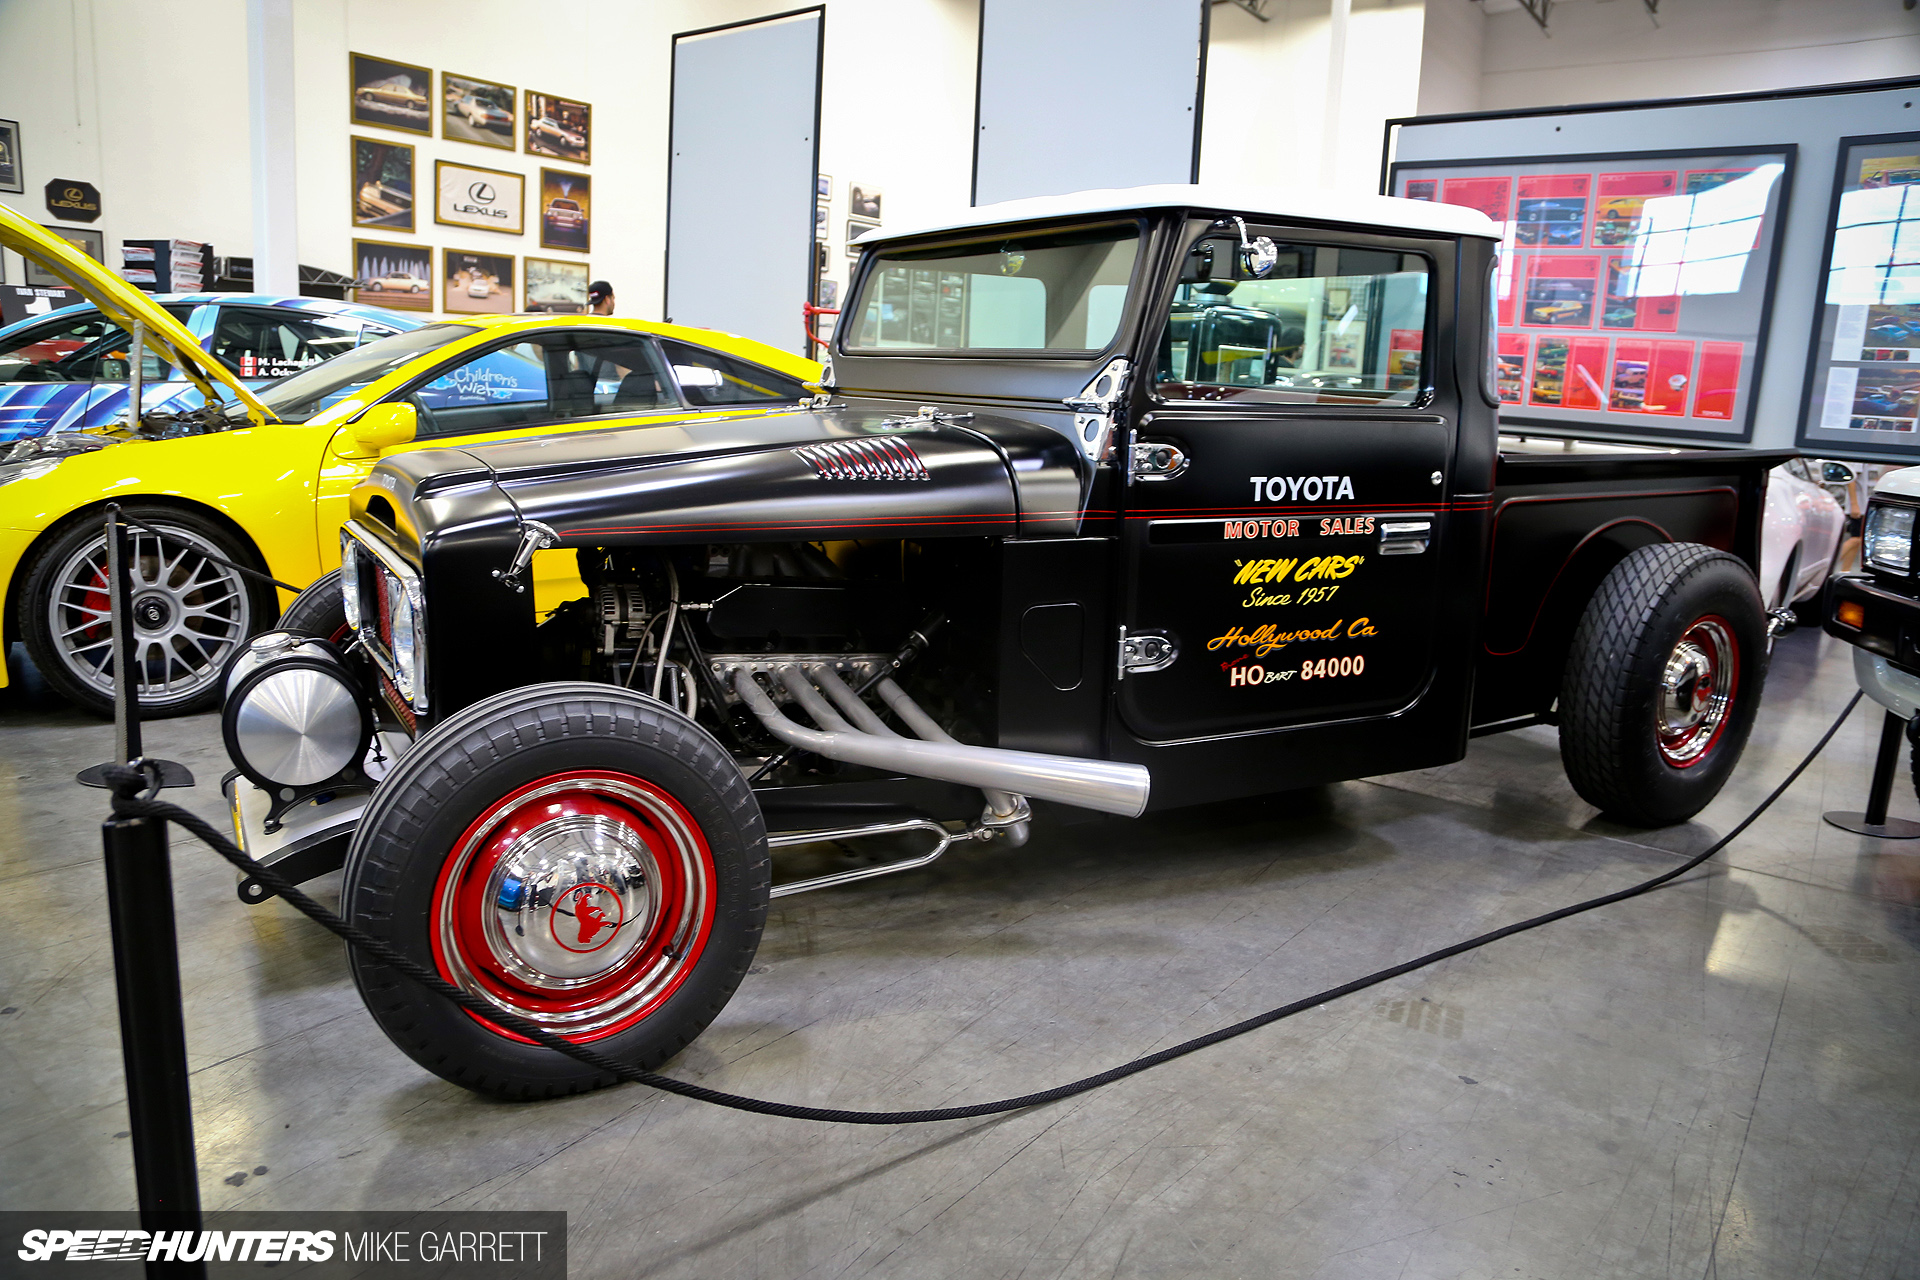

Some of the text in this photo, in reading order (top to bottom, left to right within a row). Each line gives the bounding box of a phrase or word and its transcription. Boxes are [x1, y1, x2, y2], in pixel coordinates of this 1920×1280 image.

[51, 199, 97, 211] LEXUS
[453, 203, 508, 219] LEXUS
[258, 357, 270, 366] M.
[258, 368, 269, 377] A.
[454, 367, 518, 388] Children's
[1250, 476, 1354, 501] TOYOTA
[1223, 517, 1376, 540] MOTOR SALES
[1242, 585, 1340, 608] Since 1957
[1206, 617, 1379, 658] Hollywood Ca
[1300, 655, 1365, 681] 84000
